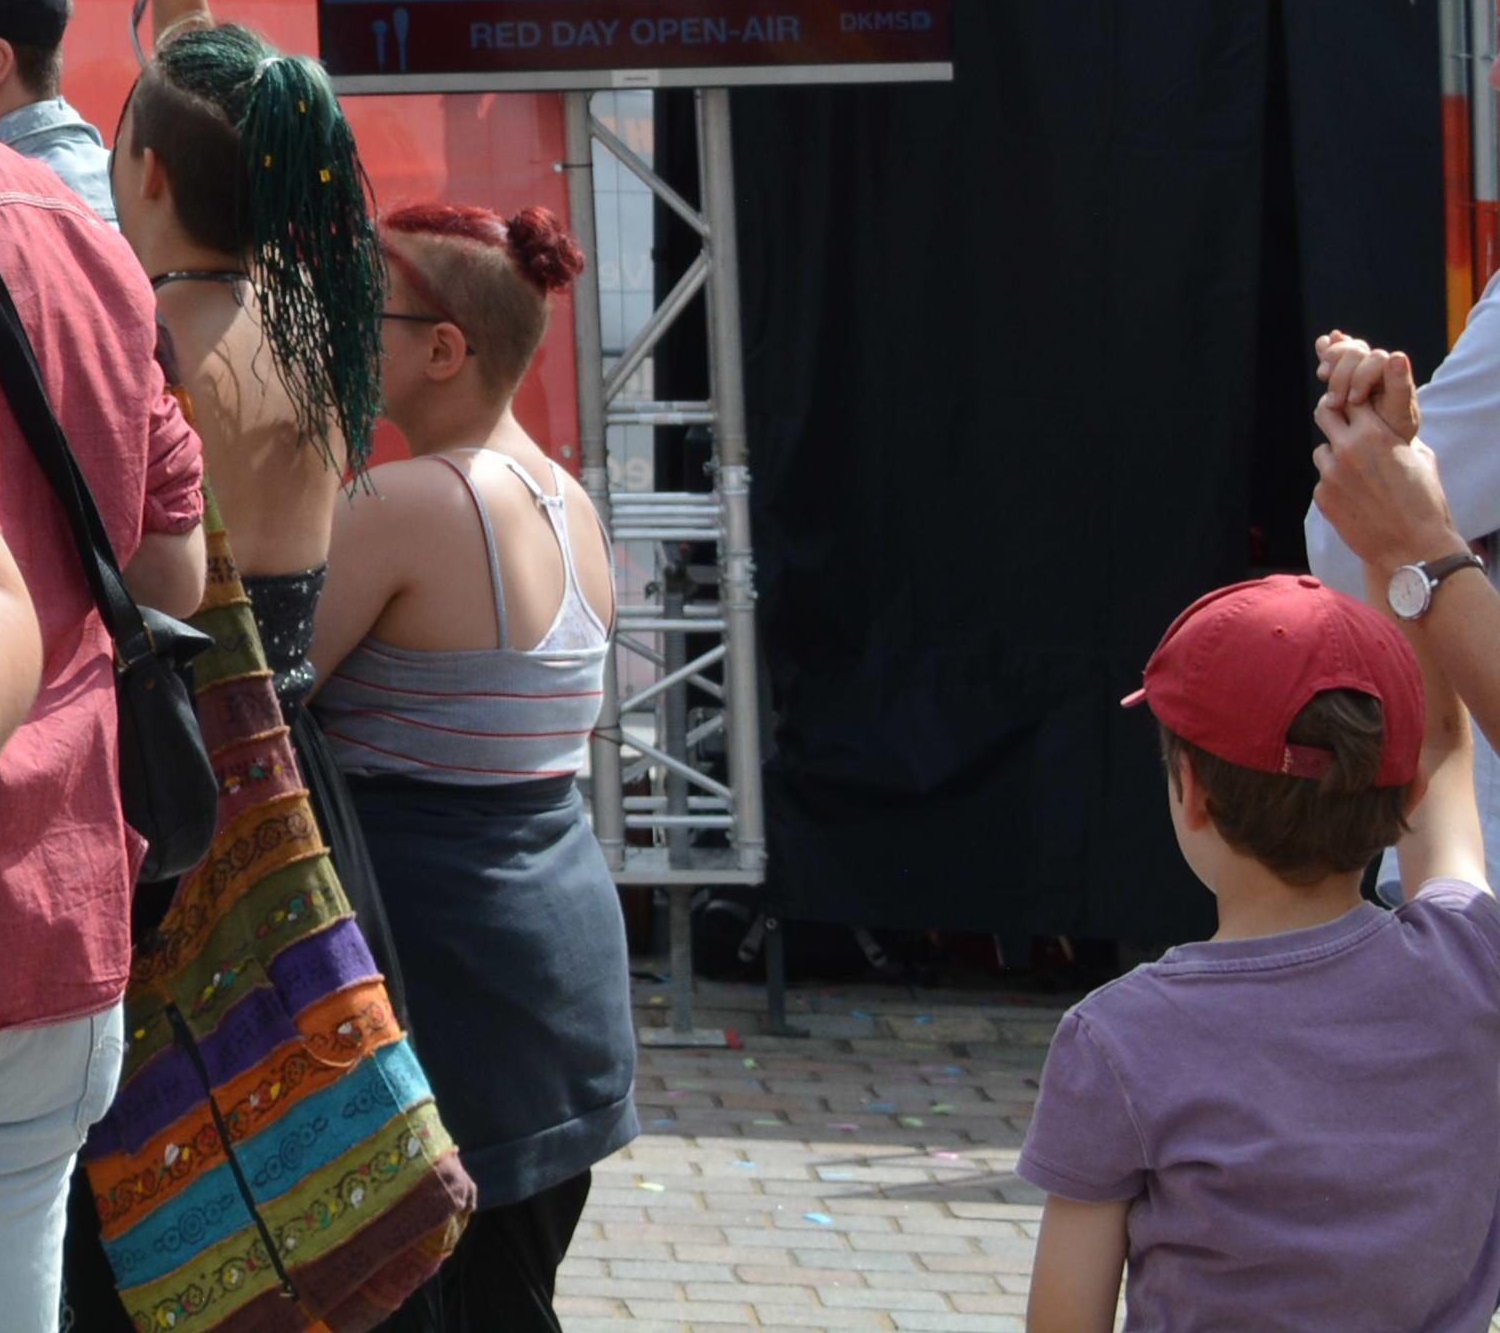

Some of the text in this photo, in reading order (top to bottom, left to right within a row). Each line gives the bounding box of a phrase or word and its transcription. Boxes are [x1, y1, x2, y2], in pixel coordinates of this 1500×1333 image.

[469, 14, 801, 50] RED DAY OPEN-AIR
[840, 10, 909, 33] DKMS
